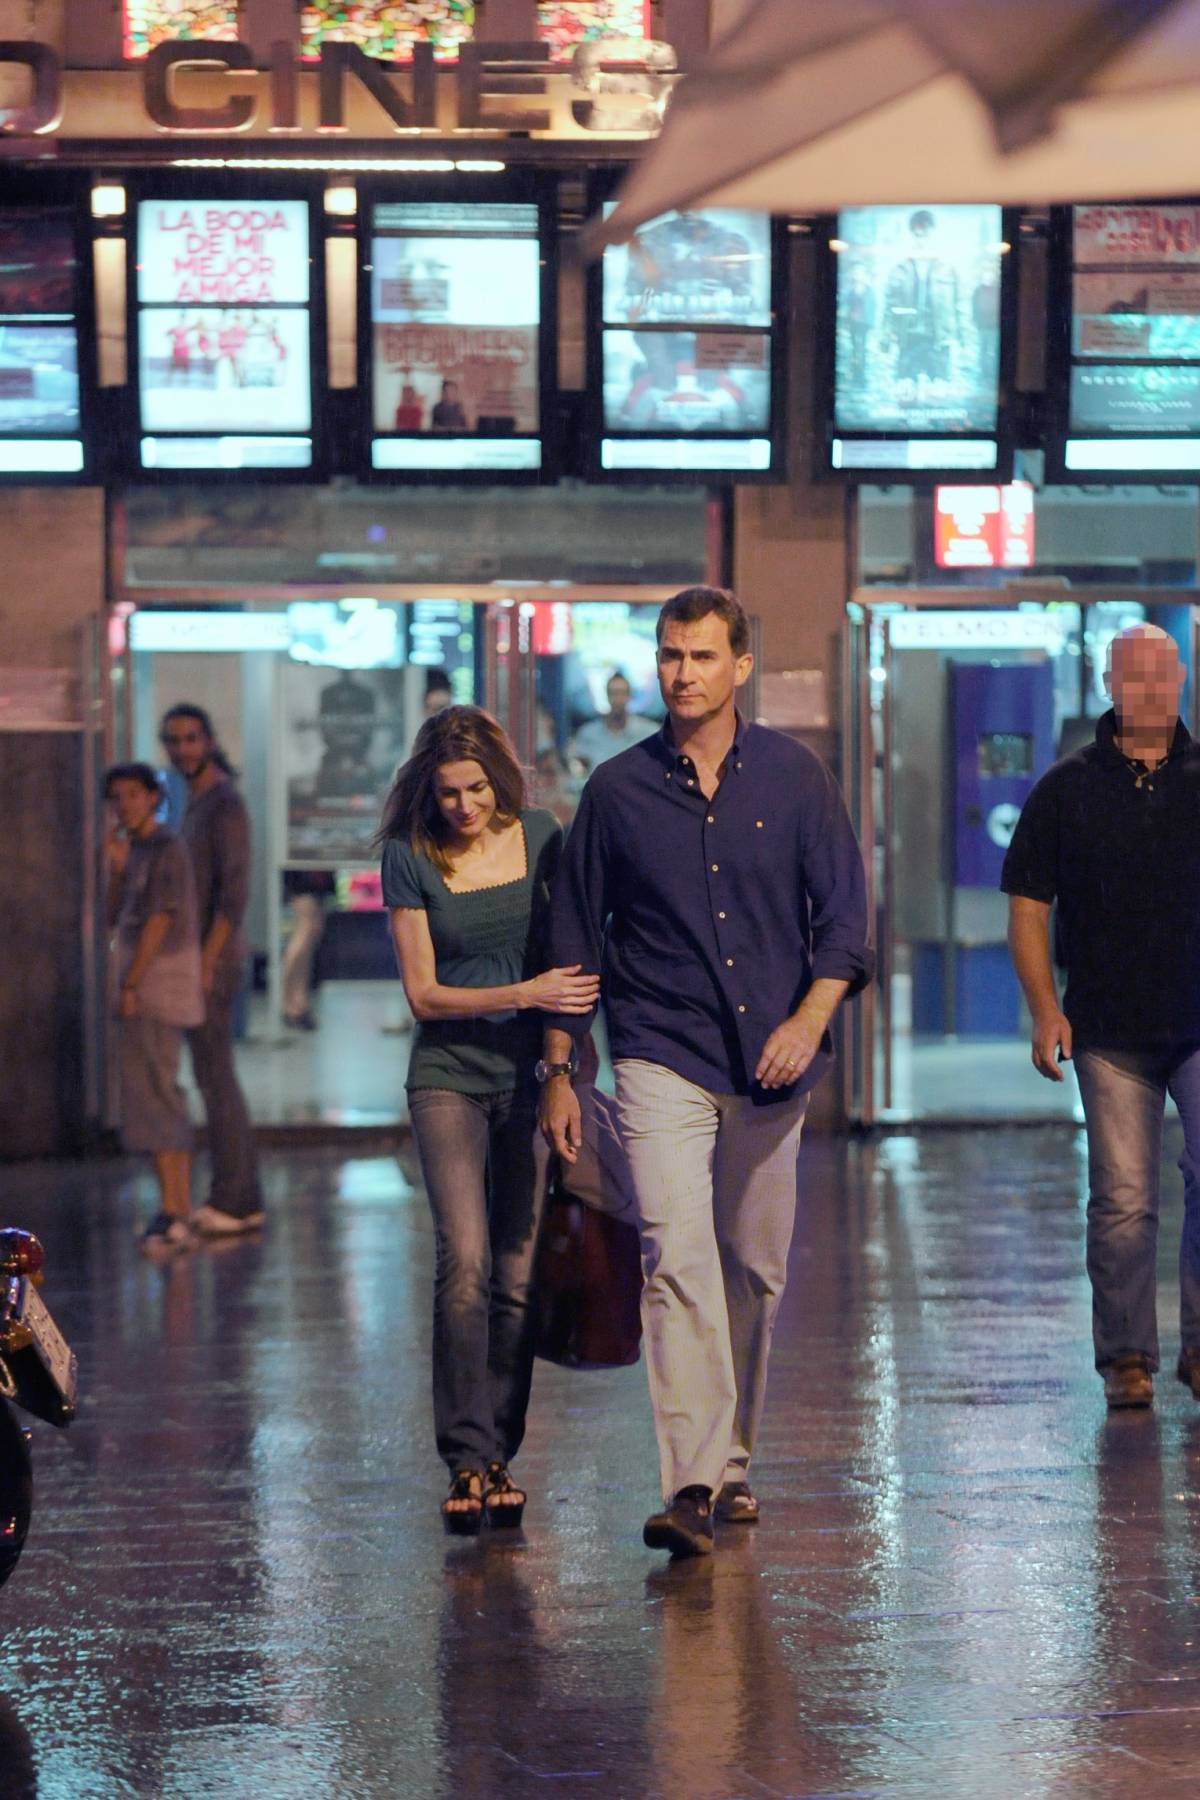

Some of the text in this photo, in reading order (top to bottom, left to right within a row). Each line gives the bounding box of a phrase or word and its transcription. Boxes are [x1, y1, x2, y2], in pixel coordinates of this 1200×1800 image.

[144, 39, 680, 137] CINES
[159, 209, 288, 232] LA BODA
[186, 232, 264, 255] DE MI
[173, 255, 275, 278] MEJOR
[175, 279, 277, 303] AMIGA
